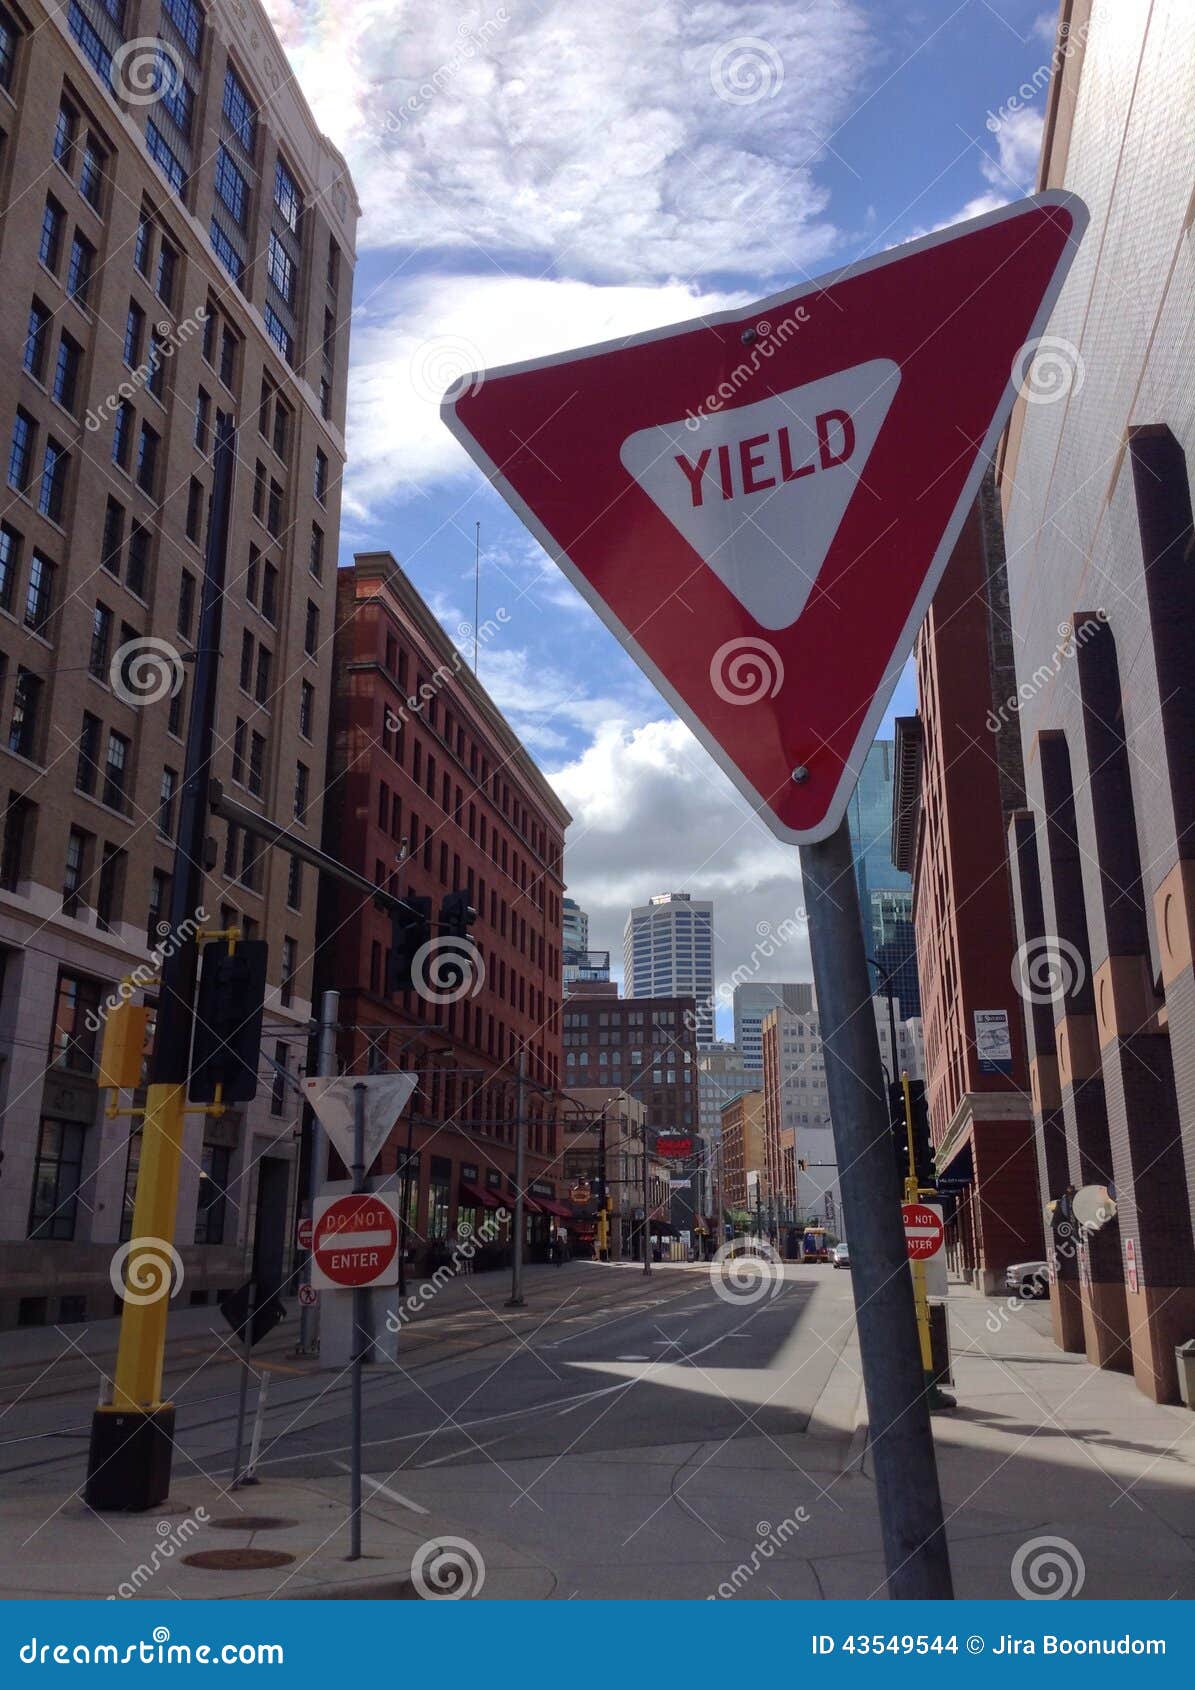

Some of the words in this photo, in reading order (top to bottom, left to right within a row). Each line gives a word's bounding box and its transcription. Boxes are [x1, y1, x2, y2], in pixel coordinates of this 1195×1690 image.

[675, 409, 856, 508] YIELD
[327, 1214, 346, 1229] DO
[355, 1211, 385, 1226] NOT
[915, 1215, 933, 1225] NOT
[908, 1240, 933, 1249] NTER
[331, 1252, 379, 1269] ENTER
